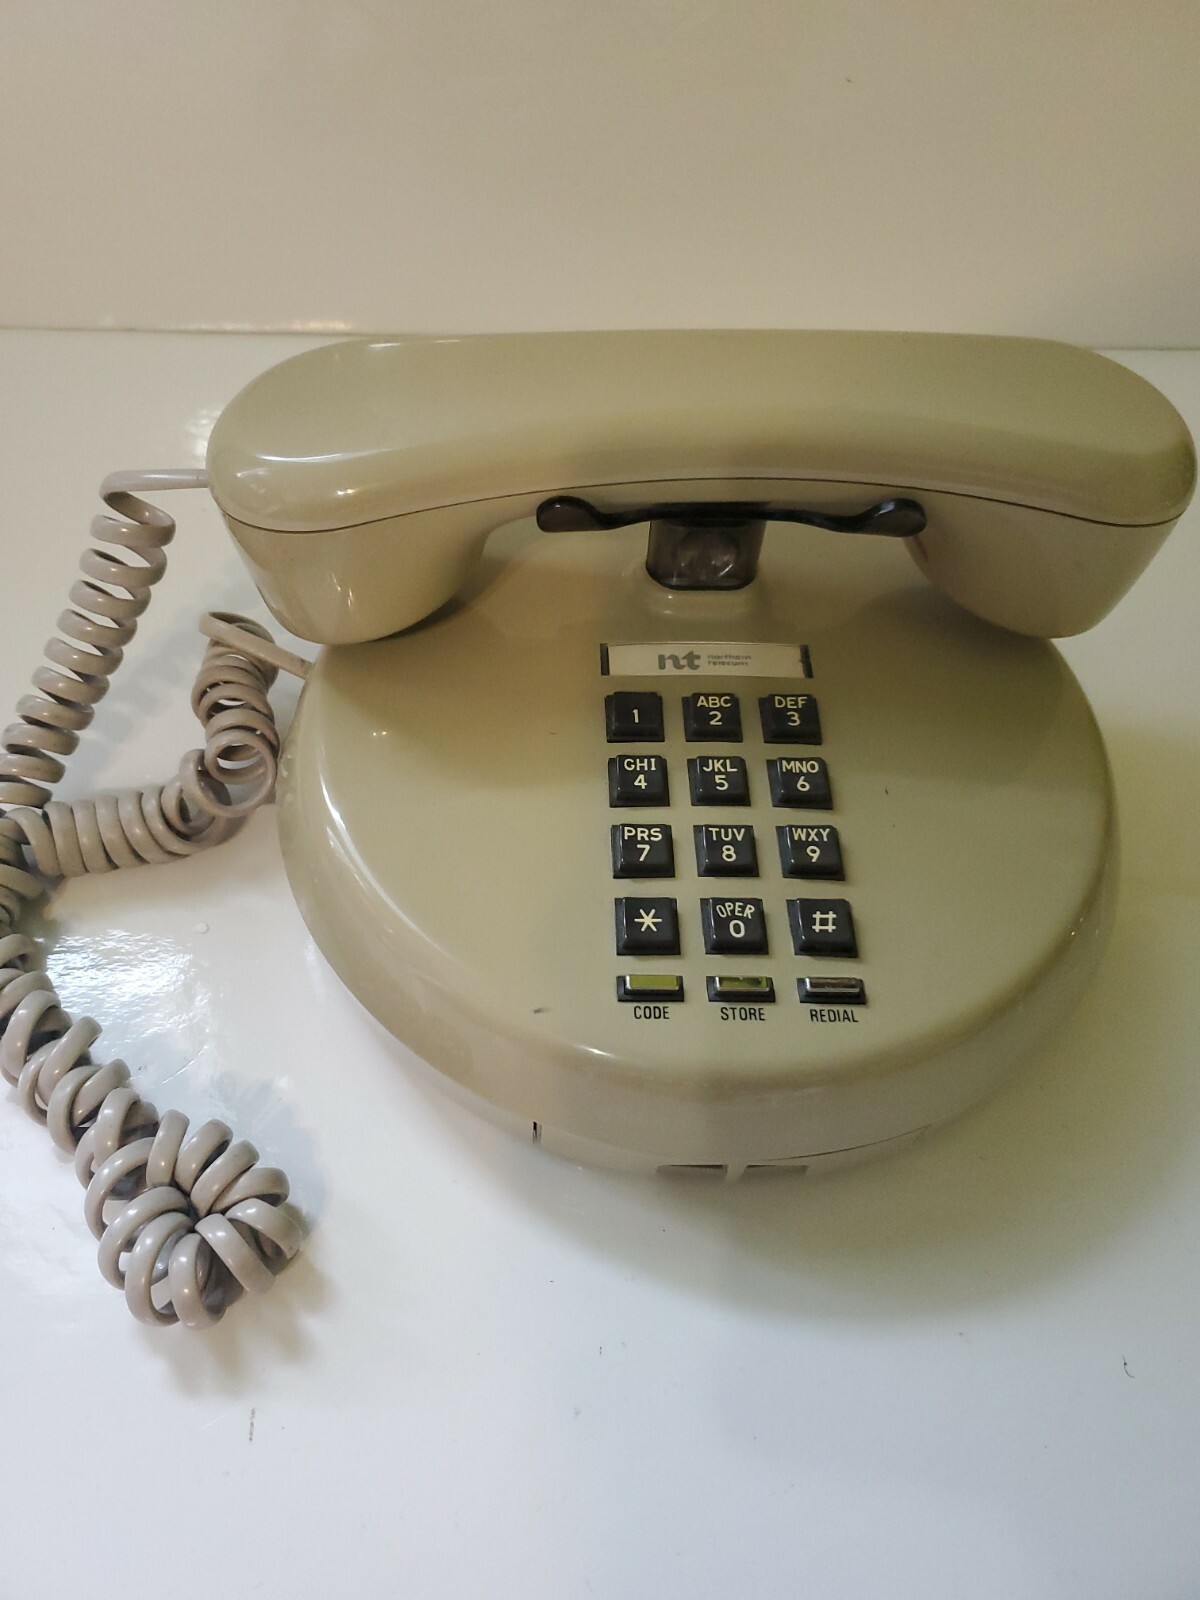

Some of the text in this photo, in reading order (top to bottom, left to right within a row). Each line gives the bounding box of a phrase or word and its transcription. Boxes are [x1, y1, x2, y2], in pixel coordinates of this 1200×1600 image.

[657, 650, 701, 671] nt
[696, 695, 732, 708] ABC
[774, 696, 808, 709] DEF
[631, 708, 640, 723] 1
[708, 711, 723, 726] 2
[787, 711, 801, 726] 3
[623, 758, 657, 771] GHI
[702, 759, 739, 772] JKL
[781, 760, 819, 774] MNO
[633, 774, 648, 790] 4
[714, 775, 729, 791] 5
[796, 776, 810, 792] 6
[623, 826, 663, 841] PRS
[708, 827, 746, 841] TUV
[791, 827, 831, 842] WXY
[636, 844, 651, 862] 7
[721, 844, 737, 862] 8
[806, 845, 821, 863] 9
[715, 901, 756, 920] OPER
[811, 910, 837, 933] #
[633, 1005, 671, 1020] CODE
[720, 1006, 766, 1021] STORE
[809, 1008, 859, 1023] REDIAL
